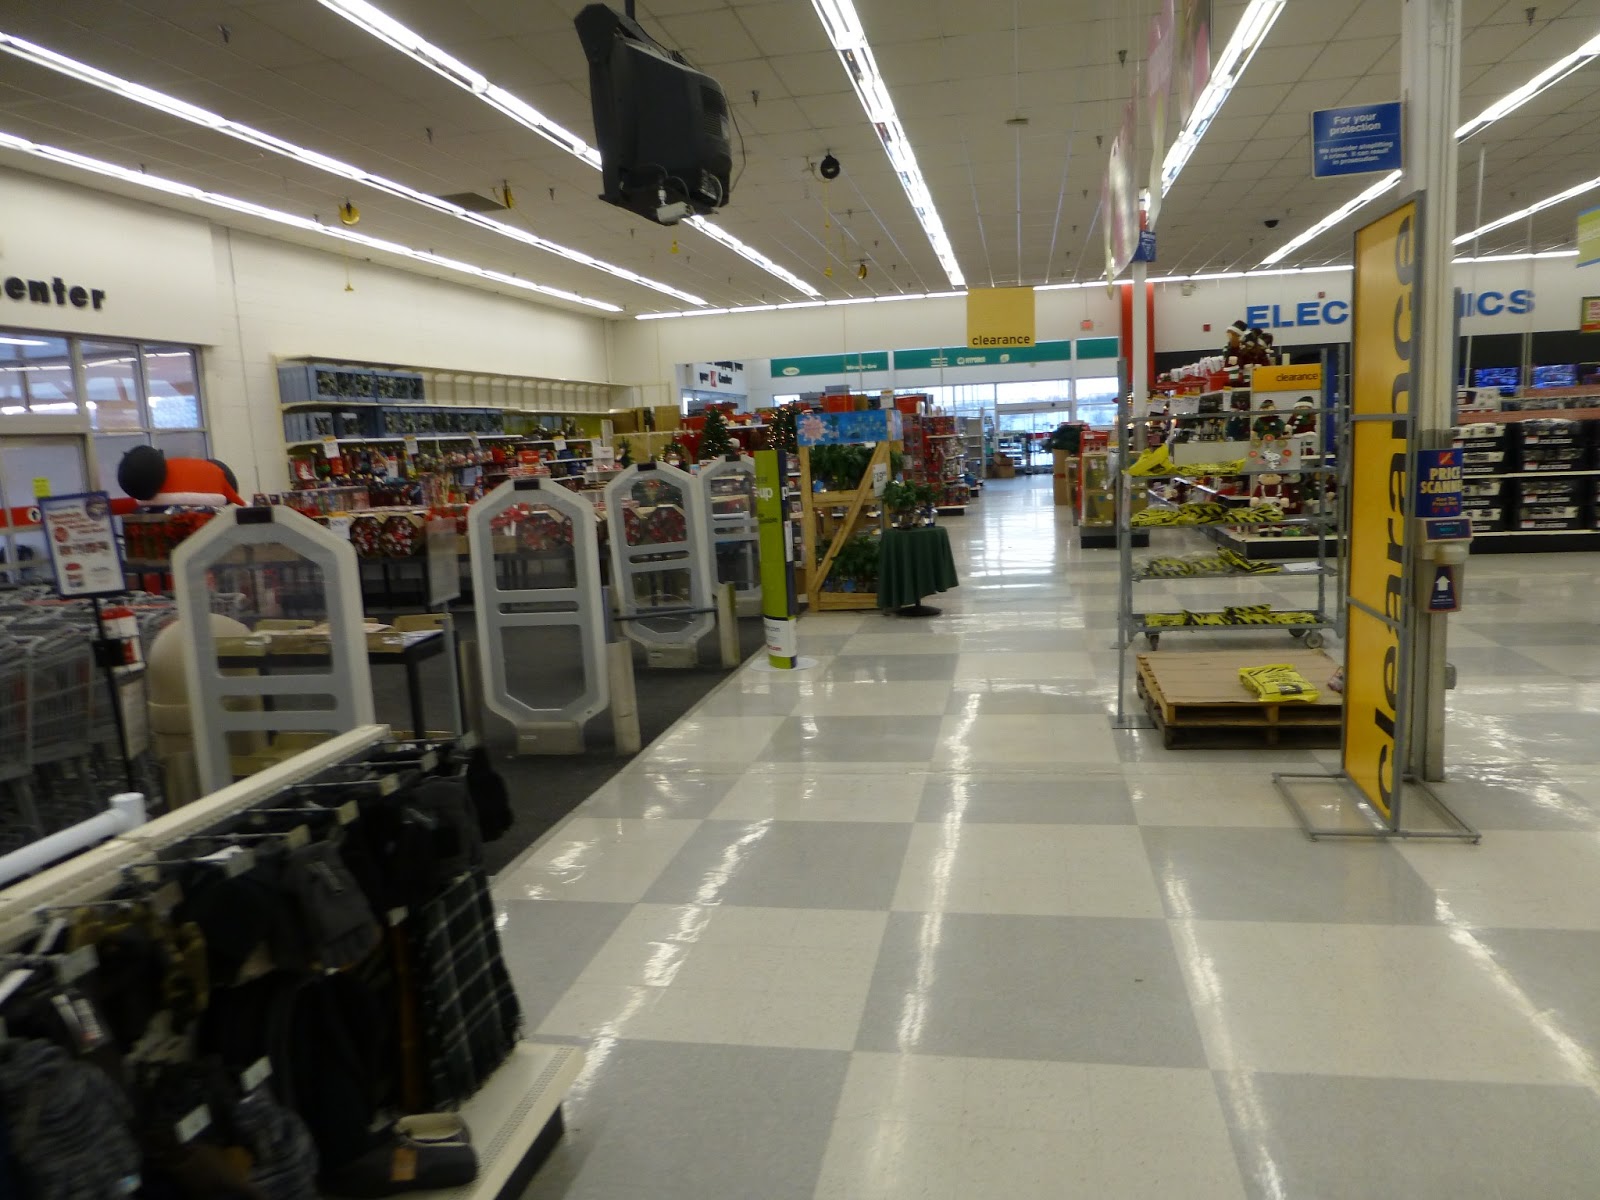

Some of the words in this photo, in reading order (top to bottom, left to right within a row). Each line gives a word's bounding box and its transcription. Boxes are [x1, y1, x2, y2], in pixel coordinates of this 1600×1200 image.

[1333, 116, 1351, 125] For
[1354, 113, 1377, 125] your
[1329, 123, 1381, 136] protection
[0, 276, 106, 310] enter
[972, 335, 1031, 346] clearance
[1276, 372, 1319, 382] clearance
